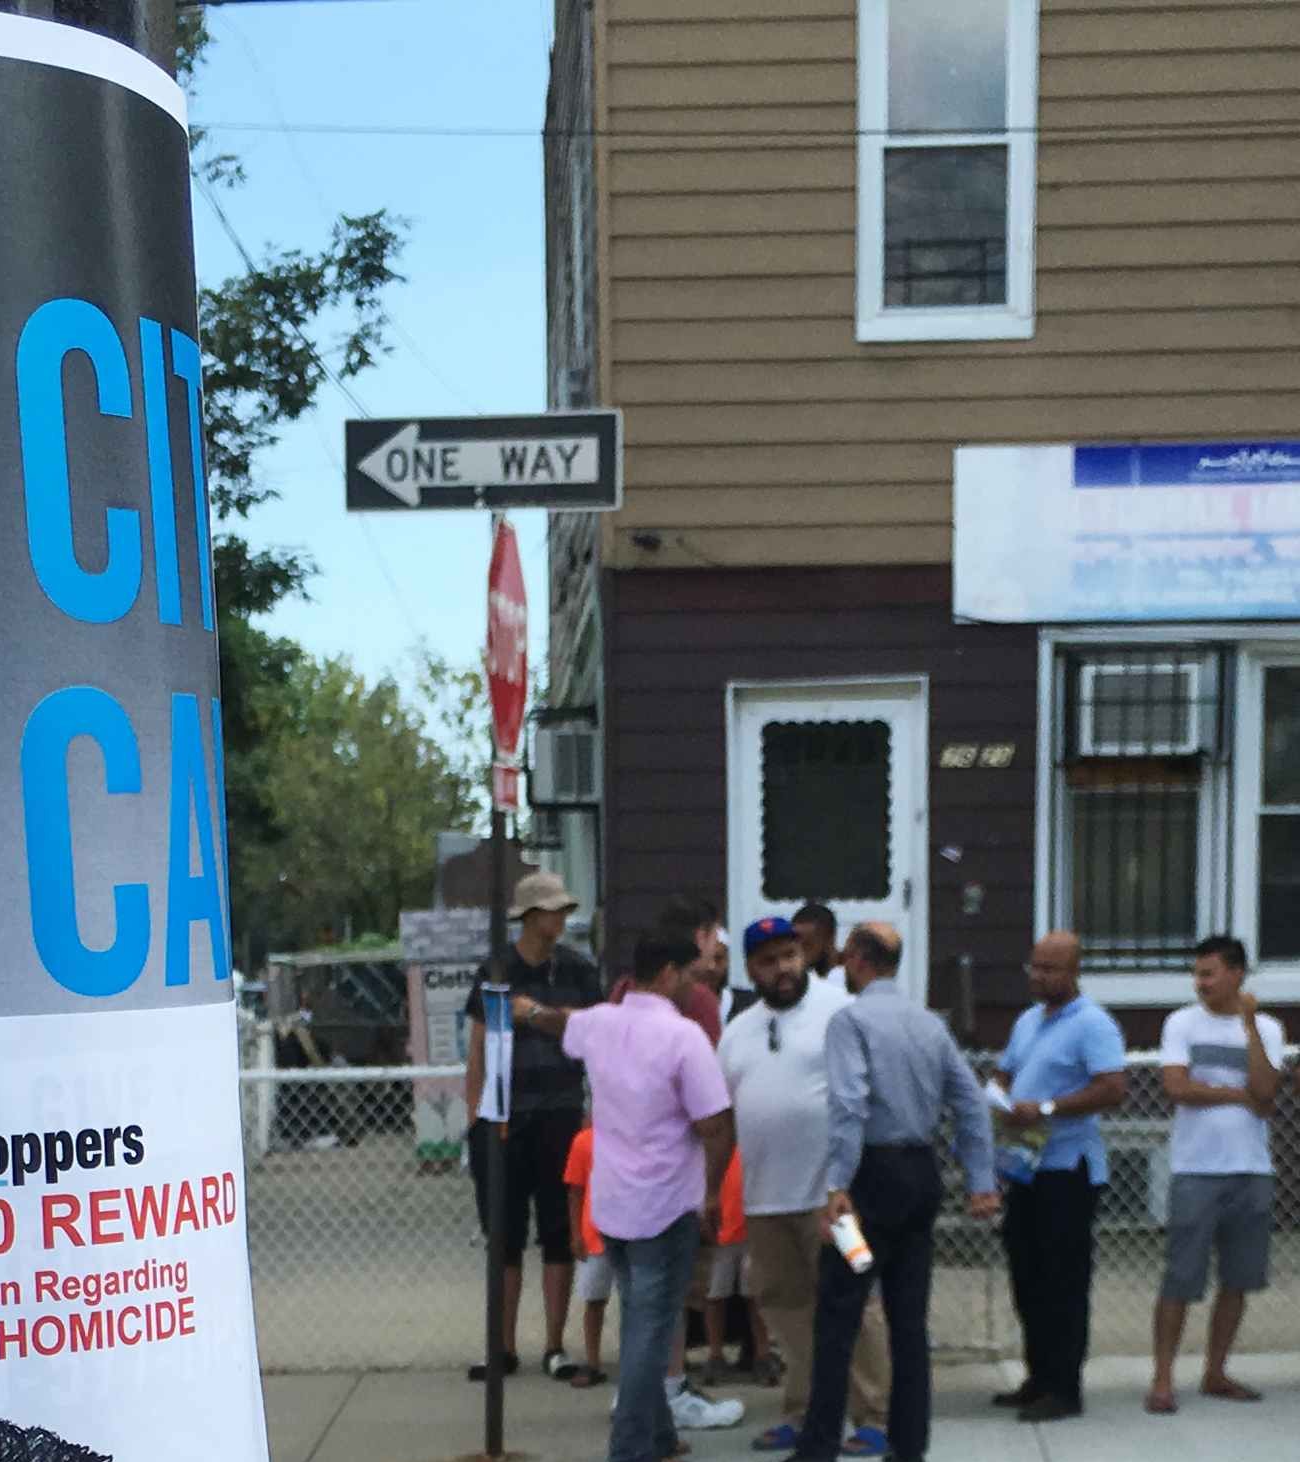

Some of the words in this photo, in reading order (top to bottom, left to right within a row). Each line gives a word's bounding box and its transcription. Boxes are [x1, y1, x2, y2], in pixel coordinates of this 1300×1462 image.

[386, 447, 461, 484] ONE
[500, 444, 582, 482] WAY
[20, 686, 232, 997] CA
[42, 1172, 239, 1250] REWARD
[35, 1259, 189, 1305] Regarding
